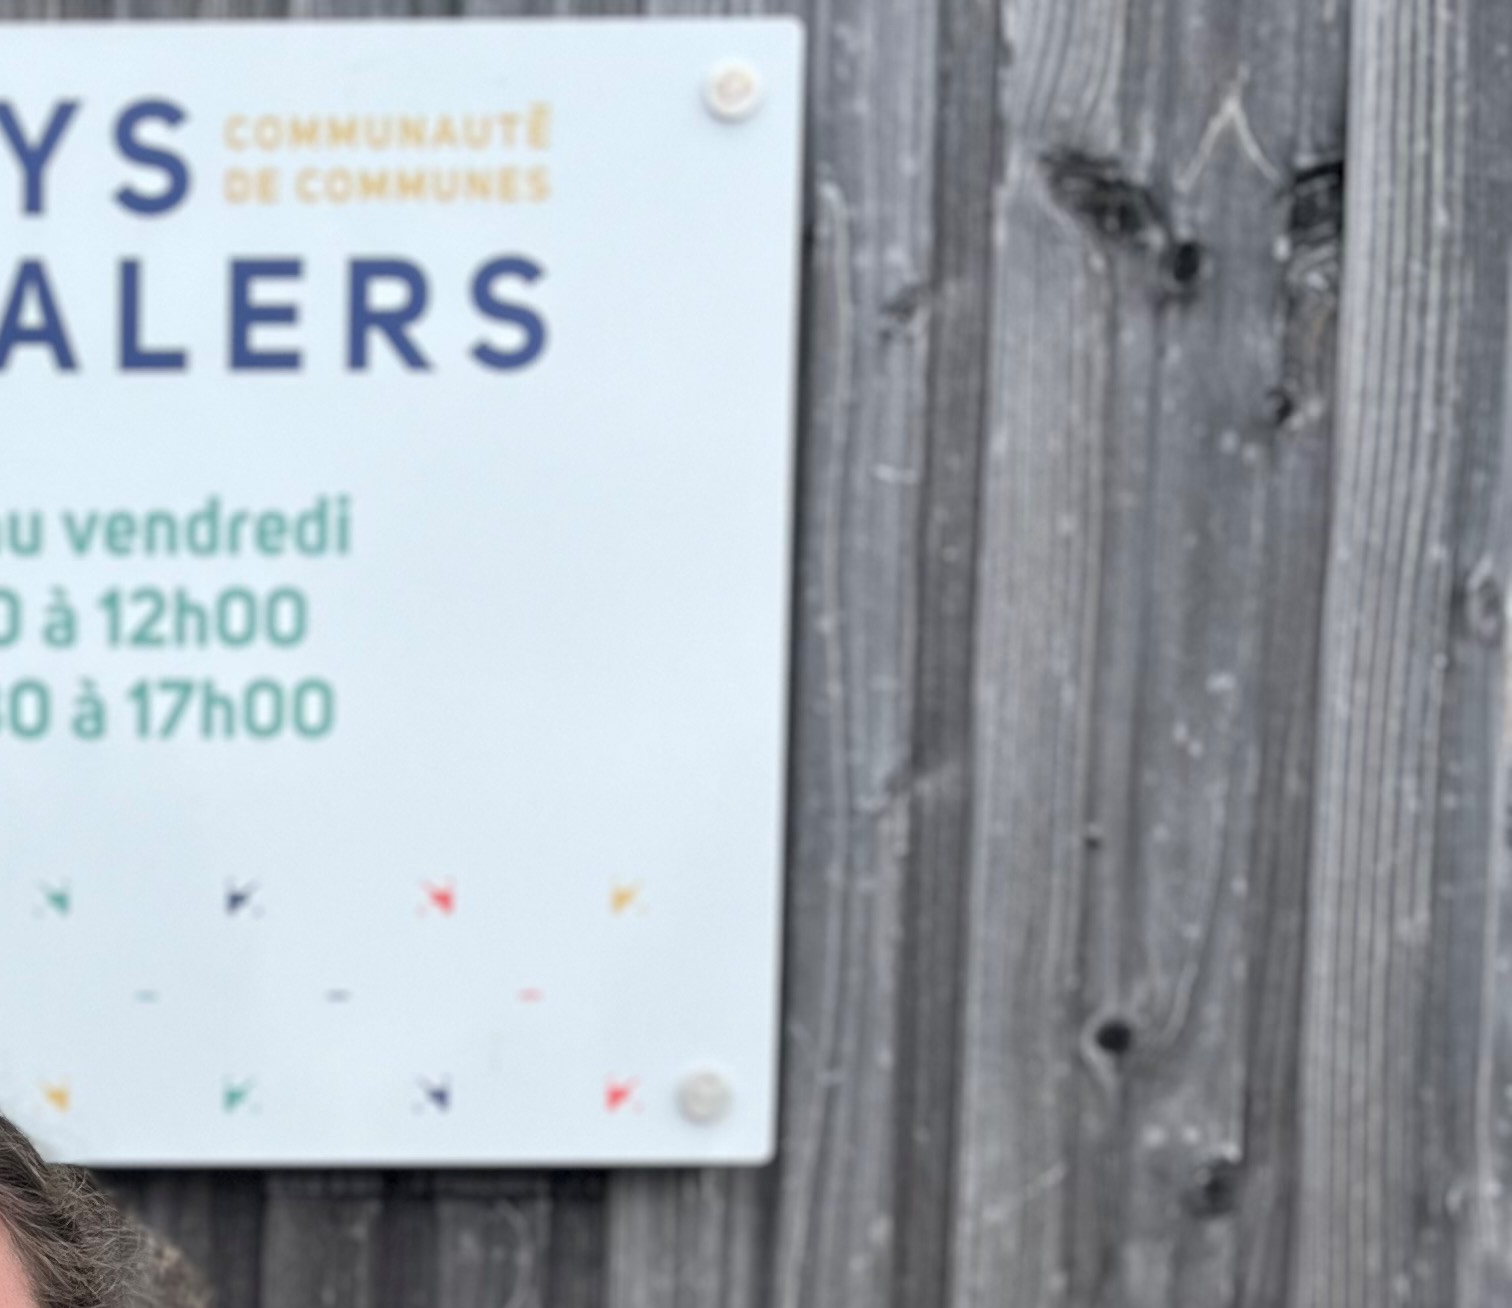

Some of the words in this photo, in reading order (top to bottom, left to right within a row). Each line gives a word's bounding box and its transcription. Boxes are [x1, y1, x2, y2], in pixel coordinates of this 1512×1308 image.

[223, 102, 552, 151] COMMUNAUTÉ
[223, 167, 277, 203] DE
[295, 167, 552, 203] COMMUNES
[61, 497, 352, 557] vendredi
[41, 587, 78, 649] à
[96, 587, 311, 649] 12h00
[71, 679, 108, 740] à
[126, 679, 336, 740] 17h00
